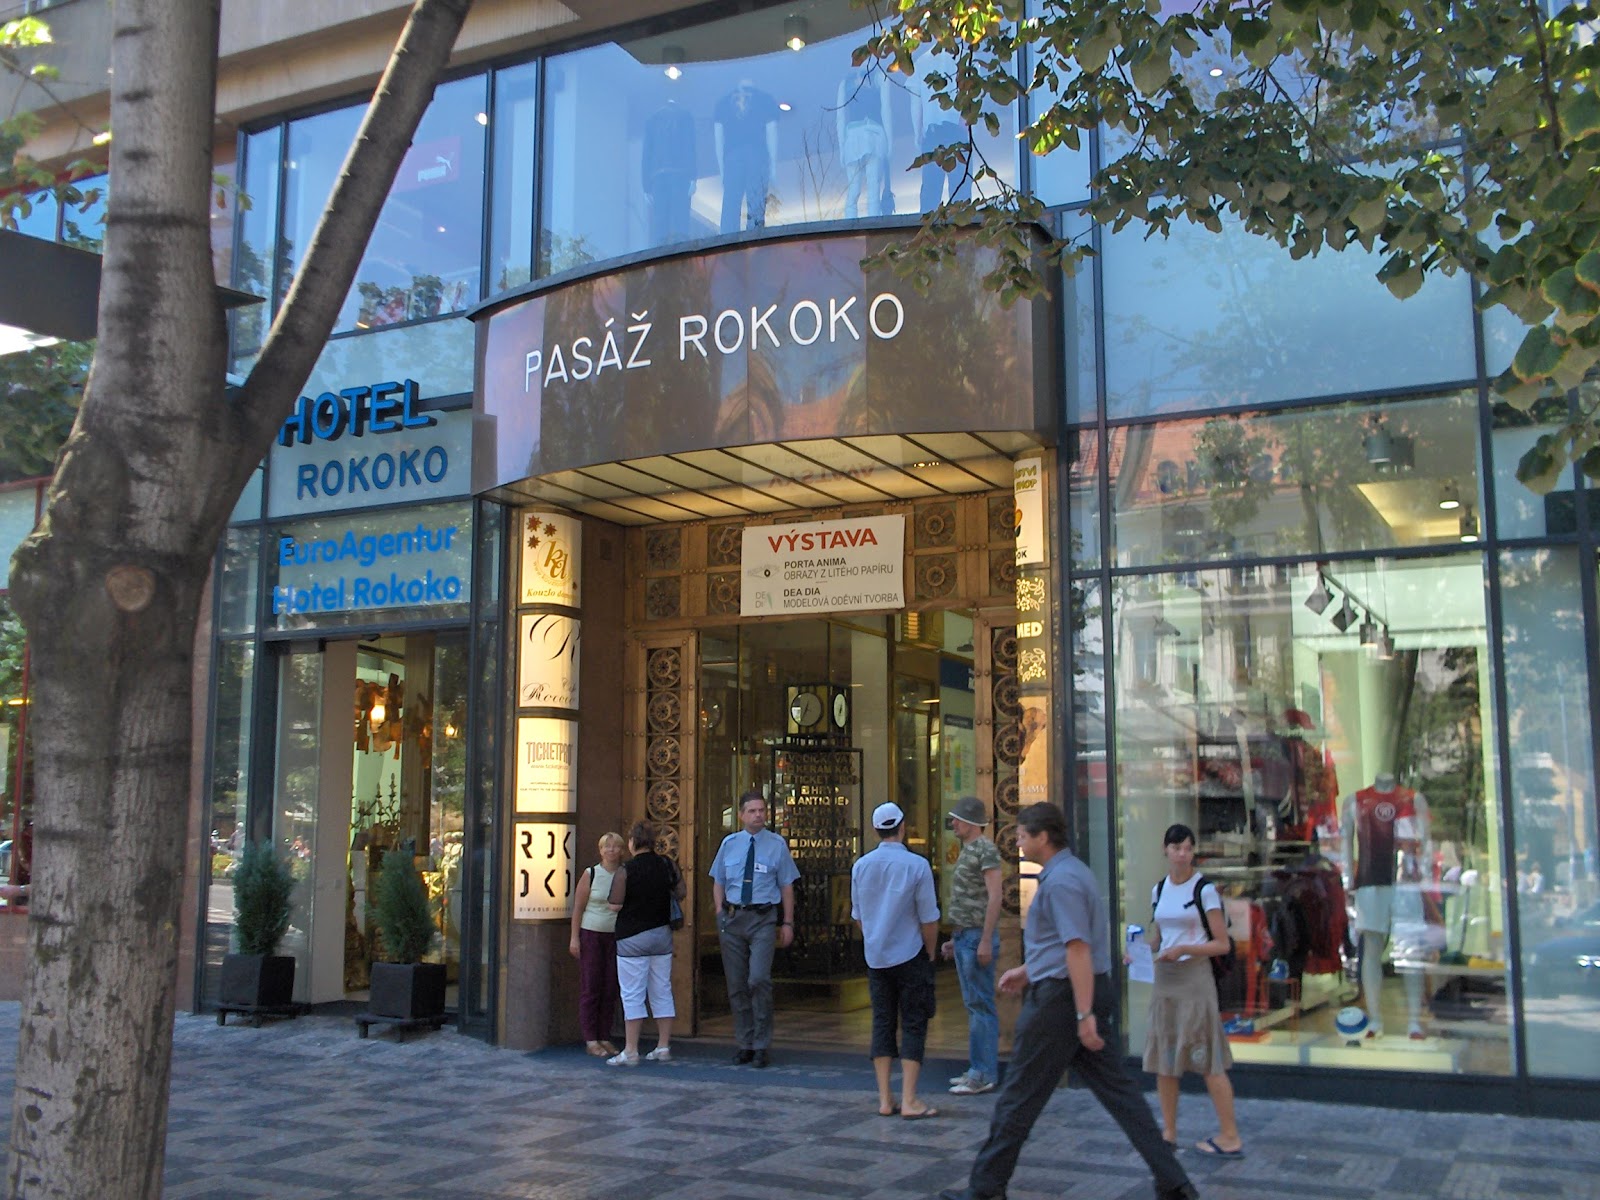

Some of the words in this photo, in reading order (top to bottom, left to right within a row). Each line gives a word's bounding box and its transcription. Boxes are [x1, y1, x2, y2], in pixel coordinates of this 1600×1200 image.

[525, 310, 653, 393] PASÁŽ
[679, 293, 904, 362] ROKOKO
[277, 378, 437, 447] HOTEL
[297, 445, 448, 500] ROKOKO
[279, 523, 458, 567] EuroAgentur
[768, 528, 878, 553] VÝSTAVA
[783, 569, 818, 580] OBRAZY
[820, 569, 826, 578] Z
[828, 566, 859, 578] LITÉHO
[860, 563, 894, 575] PAPÍRU
[784, 560, 815, 569] PORTA
[816, 557, 847, 567] ANIMA
[272, 577, 345, 615] Hotel
[353, 569, 461, 608] Rokoko
[526, 588, 556, 598] Kouzlo
[783, 588, 803, 597] DEA
[804, 587, 821, 596] DIA
[783, 596, 830, 608] MODELOVÁ
[831, 594, 862, 605] ODĚVNÍ
[864, 592, 899, 603] TVORBA
